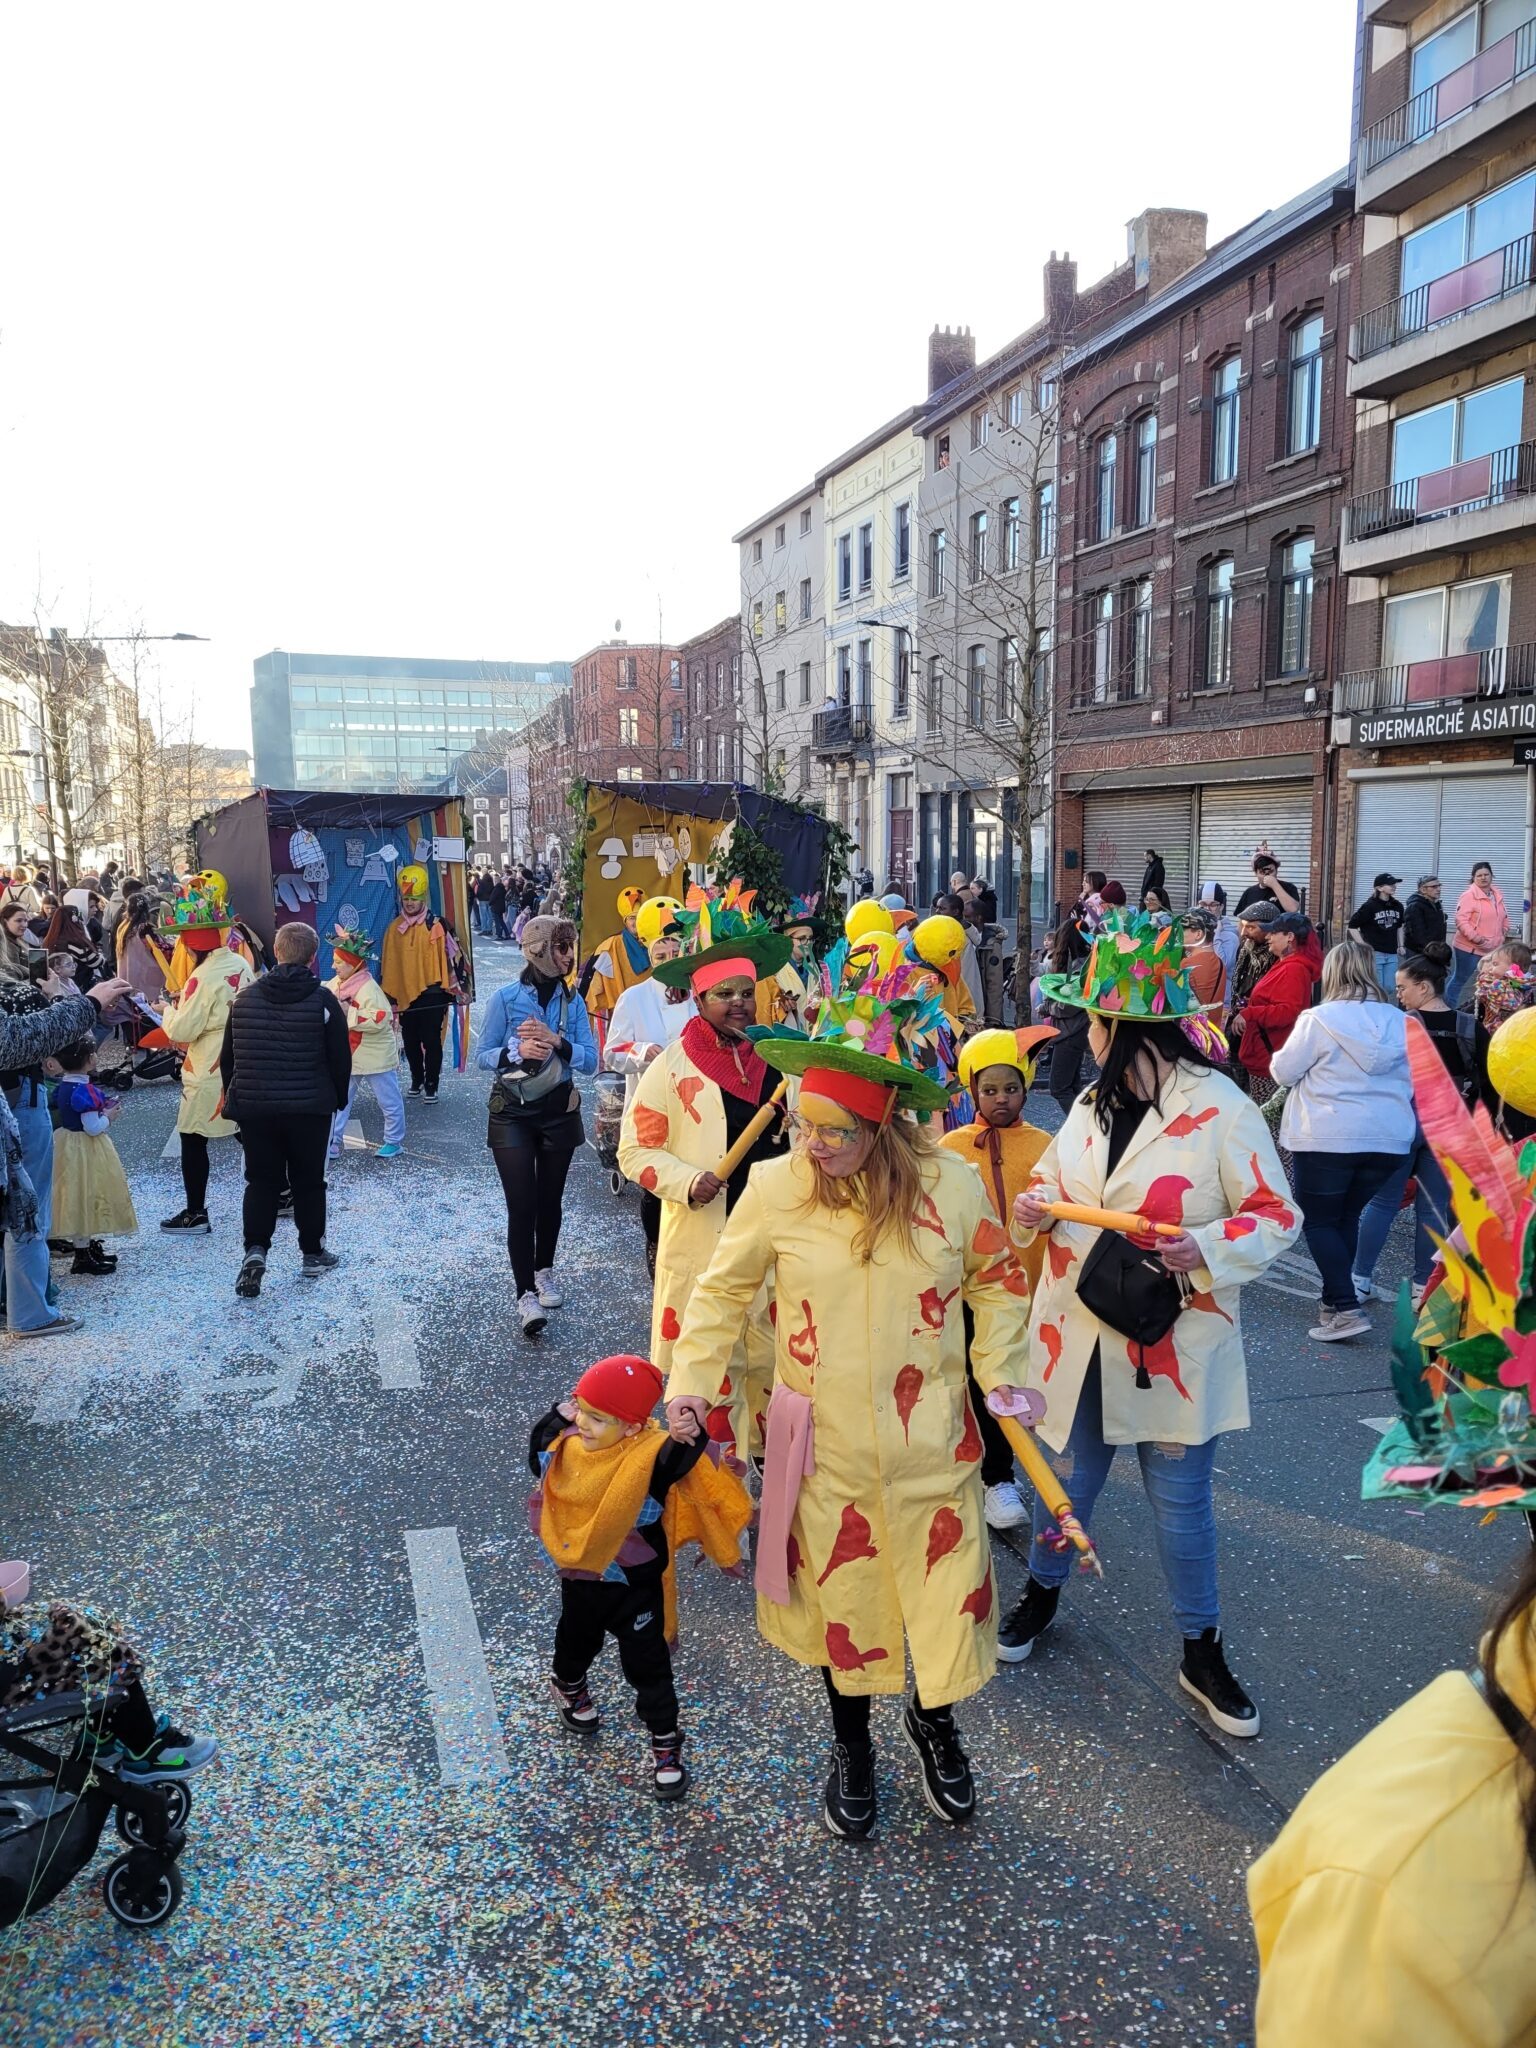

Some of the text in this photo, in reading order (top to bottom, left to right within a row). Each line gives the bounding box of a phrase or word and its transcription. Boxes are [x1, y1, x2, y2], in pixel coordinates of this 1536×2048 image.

[1359, 703, 1536, 743] SUPERMARCHÉ ASIATIQ
[636, 1610, 653, 1623] NIKE
